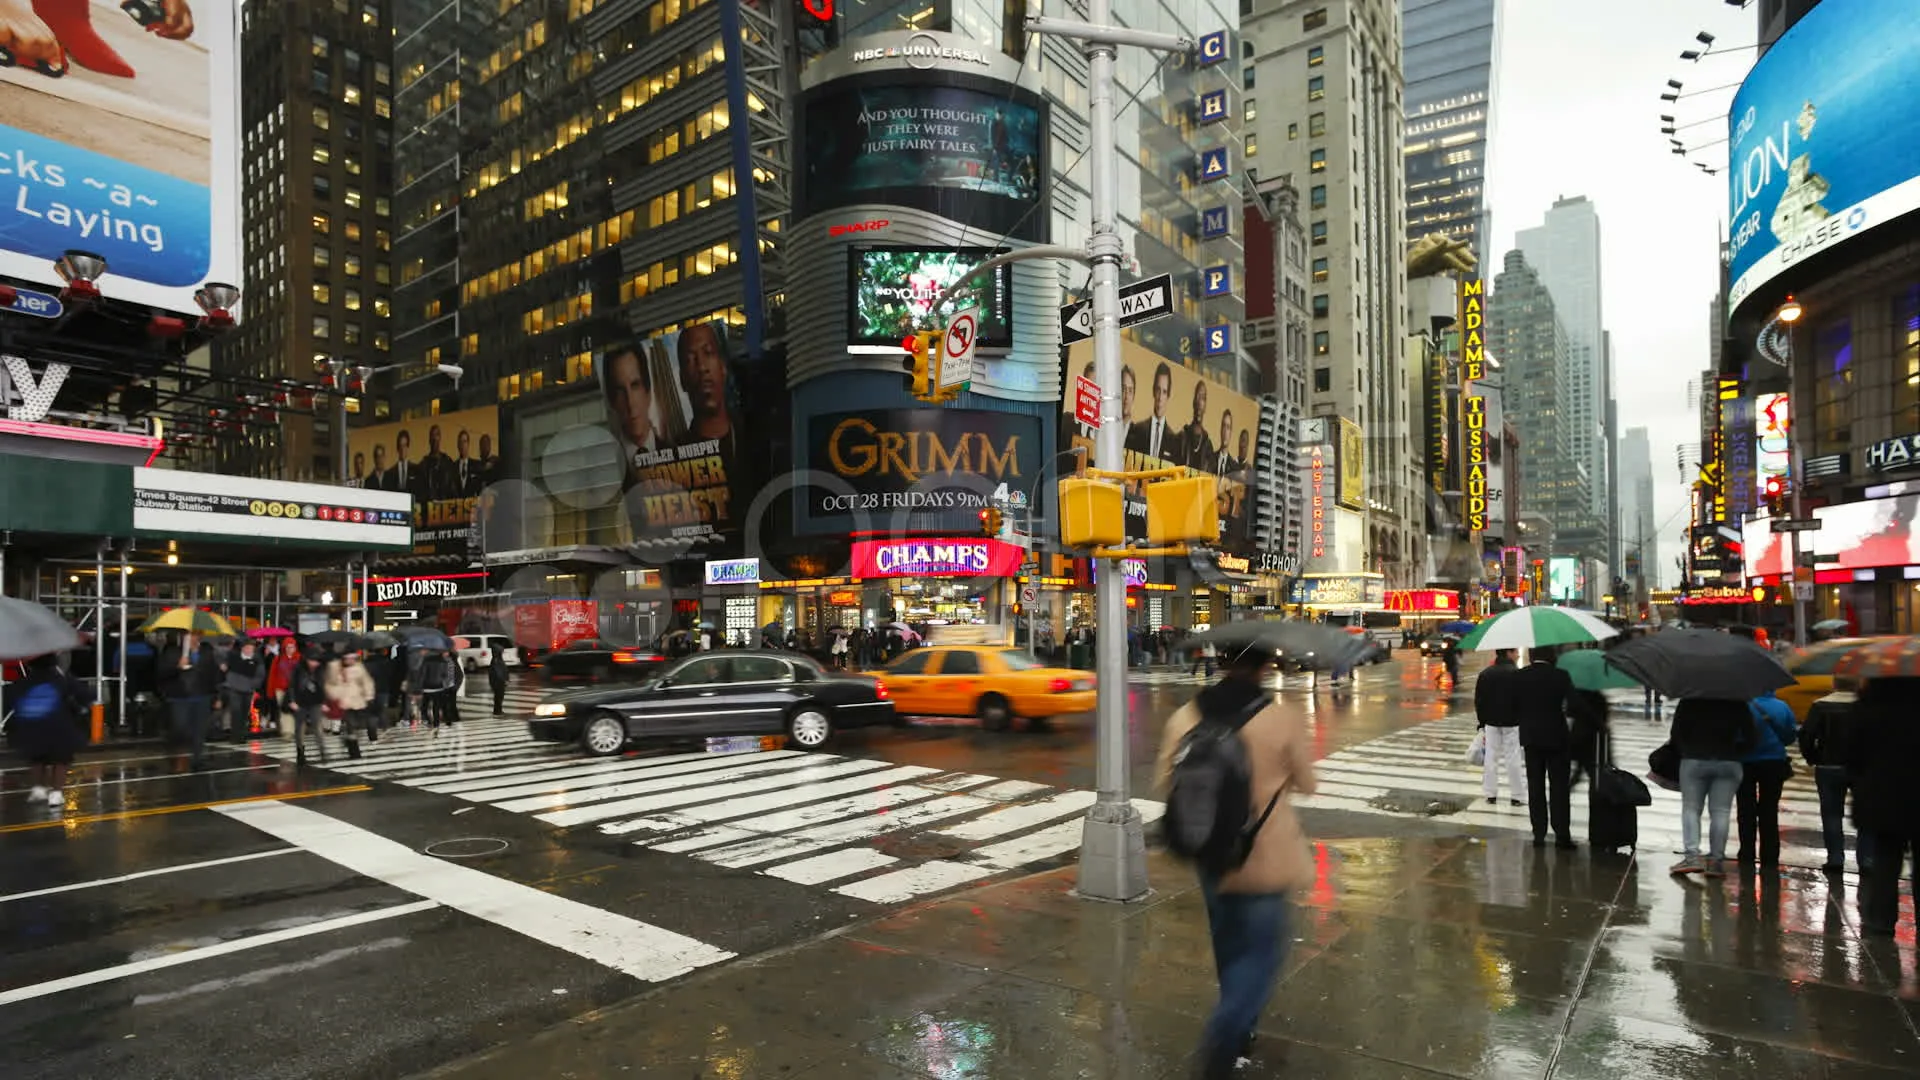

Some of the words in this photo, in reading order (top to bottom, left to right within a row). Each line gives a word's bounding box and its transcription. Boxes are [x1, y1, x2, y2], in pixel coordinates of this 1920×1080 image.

[854, 48, 883, 62] NBC
[903, 47, 991, 65] UNIVERSAL
[857, 111, 887, 124] AND
[890, 108, 918, 120] YOU
[921, 108, 987, 124] THOUGHT
[887, 124, 920, 135] THEY
[924, 124, 959, 136] WERE
[867, 141, 896, 154] JUST
[900, 139, 936, 150] FAIRY
[1204, 36, 1224, 349] CHAMPS
[16, 185, 164, 252] Laying
[829, 219, 889, 237] SHARP
[1782, 218, 1840, 263] CHASE
[893, 288, 921, 300] YOU
[1121, 292, 1155, 315] WAY
[1463, 280, 1483, 380] MADAME
[635, 449, 674, 467] STILLER
[678, 440, 720, 458] MURPHY
[135, 490, 166, 500] Times
[221, 496, 248, 506] Street
[135, 498, 176, 511] Subway
[178, 501, 213, 512] Station
[643, 486, 731, 526] HEIST
[823, 494, 857, 511] OCT
[860, 493, 879, 508] 28
[882, 492, 954, 508] FRIDAYS
[959, 492, 988, 507] 9PM
[994, 482, 1010, 503] 4
[1312, 446, 1323, 557] AMSTERDAM
[876, 545, 988, 571] CHAMPS
[1218, 552, 1249, 573] Subway
[712, 562, 757, 580] CHAMPS
[376, 583, 404, 601] RED
[405, 578, 457, 596] LOBSTER
[1310, 590, 1358, 601] POPPINS
[1317, 579, 1349, 592] MARY
